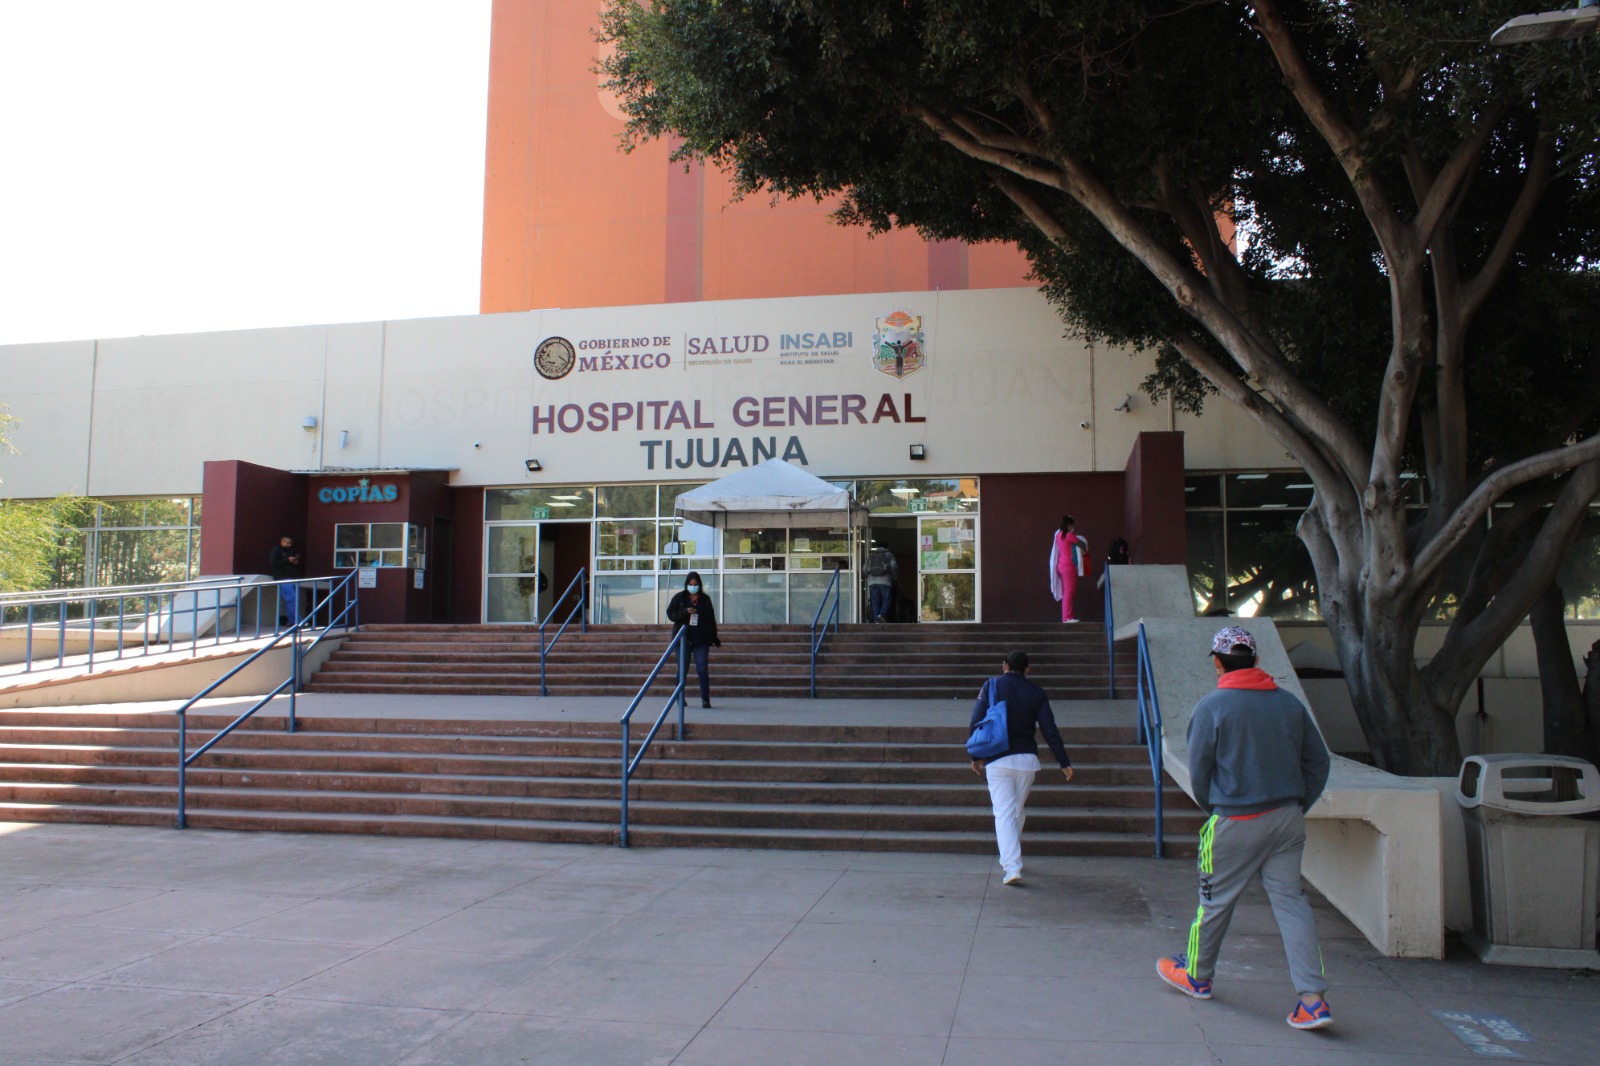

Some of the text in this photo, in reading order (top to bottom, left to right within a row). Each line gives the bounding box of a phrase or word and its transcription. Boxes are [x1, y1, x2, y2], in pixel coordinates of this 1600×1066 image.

[578, 336, 671, 350] GOBIERNO DE
[688, 335, 769, 355] SALUD
[780, 332, 853, 350] INSABI
[578, 350, 671, 372] MÉXICO
[532, 399, 714, 435] HOSPITAL
[732, 393, 927, 428] GENERAL
[640, 436, 809, 470] TIJUANA
